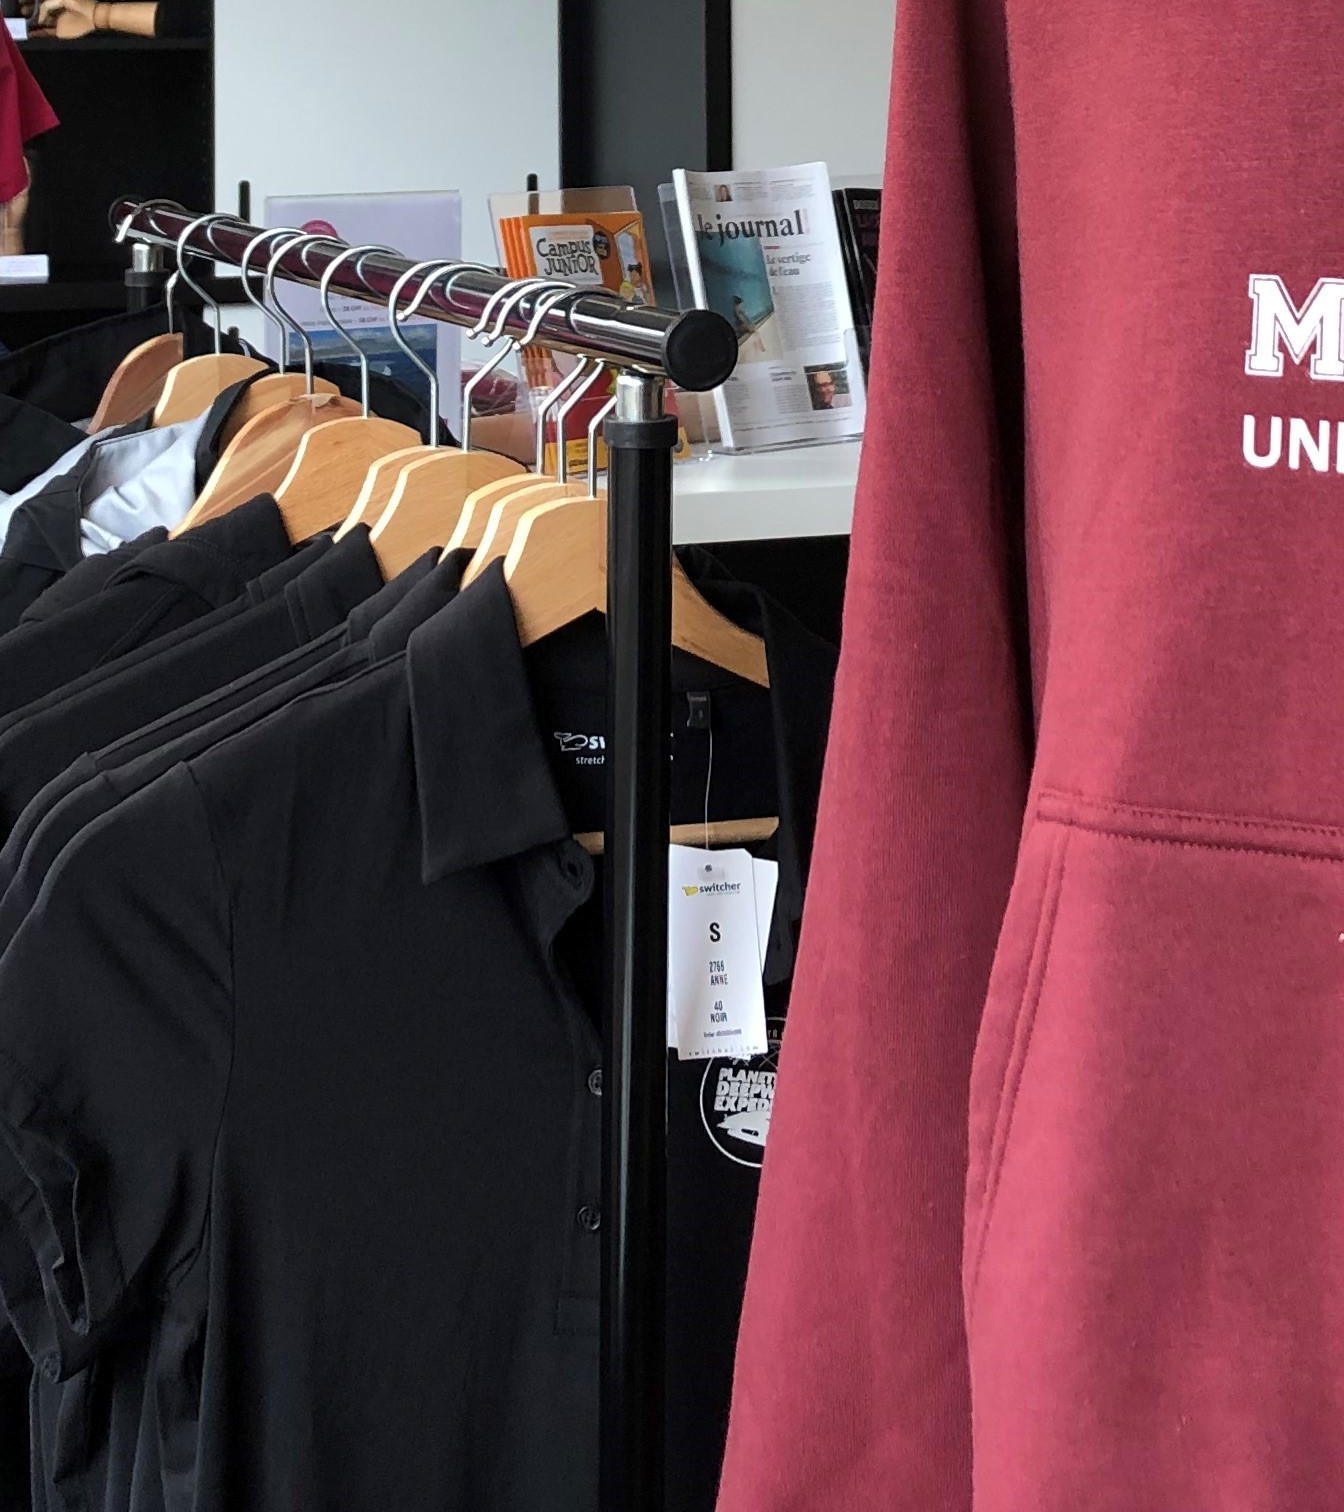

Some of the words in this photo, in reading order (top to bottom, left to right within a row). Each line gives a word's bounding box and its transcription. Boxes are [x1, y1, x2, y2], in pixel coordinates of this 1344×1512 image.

[715, 209, 805, 247] journal
[699, 881, 742, 894] switcher
[709, 921, 722, 943] S
[714, 1000, 724, 1012] 40
